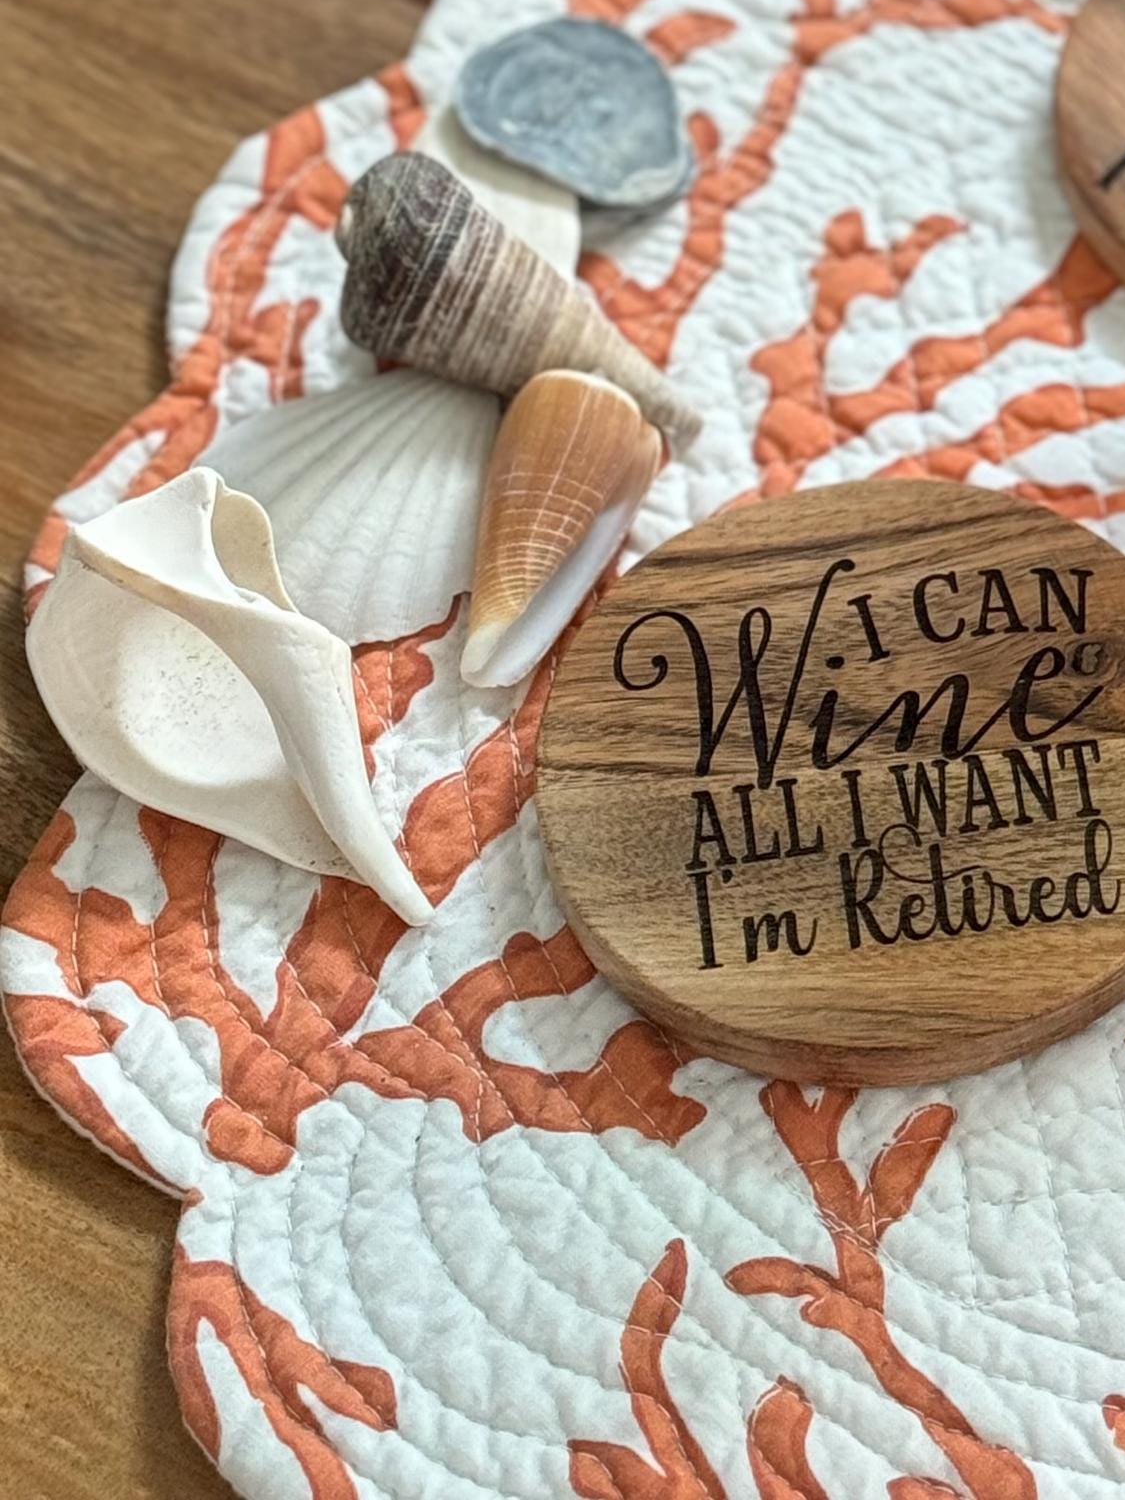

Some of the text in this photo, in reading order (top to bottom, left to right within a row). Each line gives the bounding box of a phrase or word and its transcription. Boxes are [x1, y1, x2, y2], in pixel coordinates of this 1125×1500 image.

[613, 558, 1107, 790] Wine
[847, 567, 1094, 662] I CAN
[685, 739, 1102, 870] ALL I WANT
[689, 818, 1121, 970] I'm Retired
